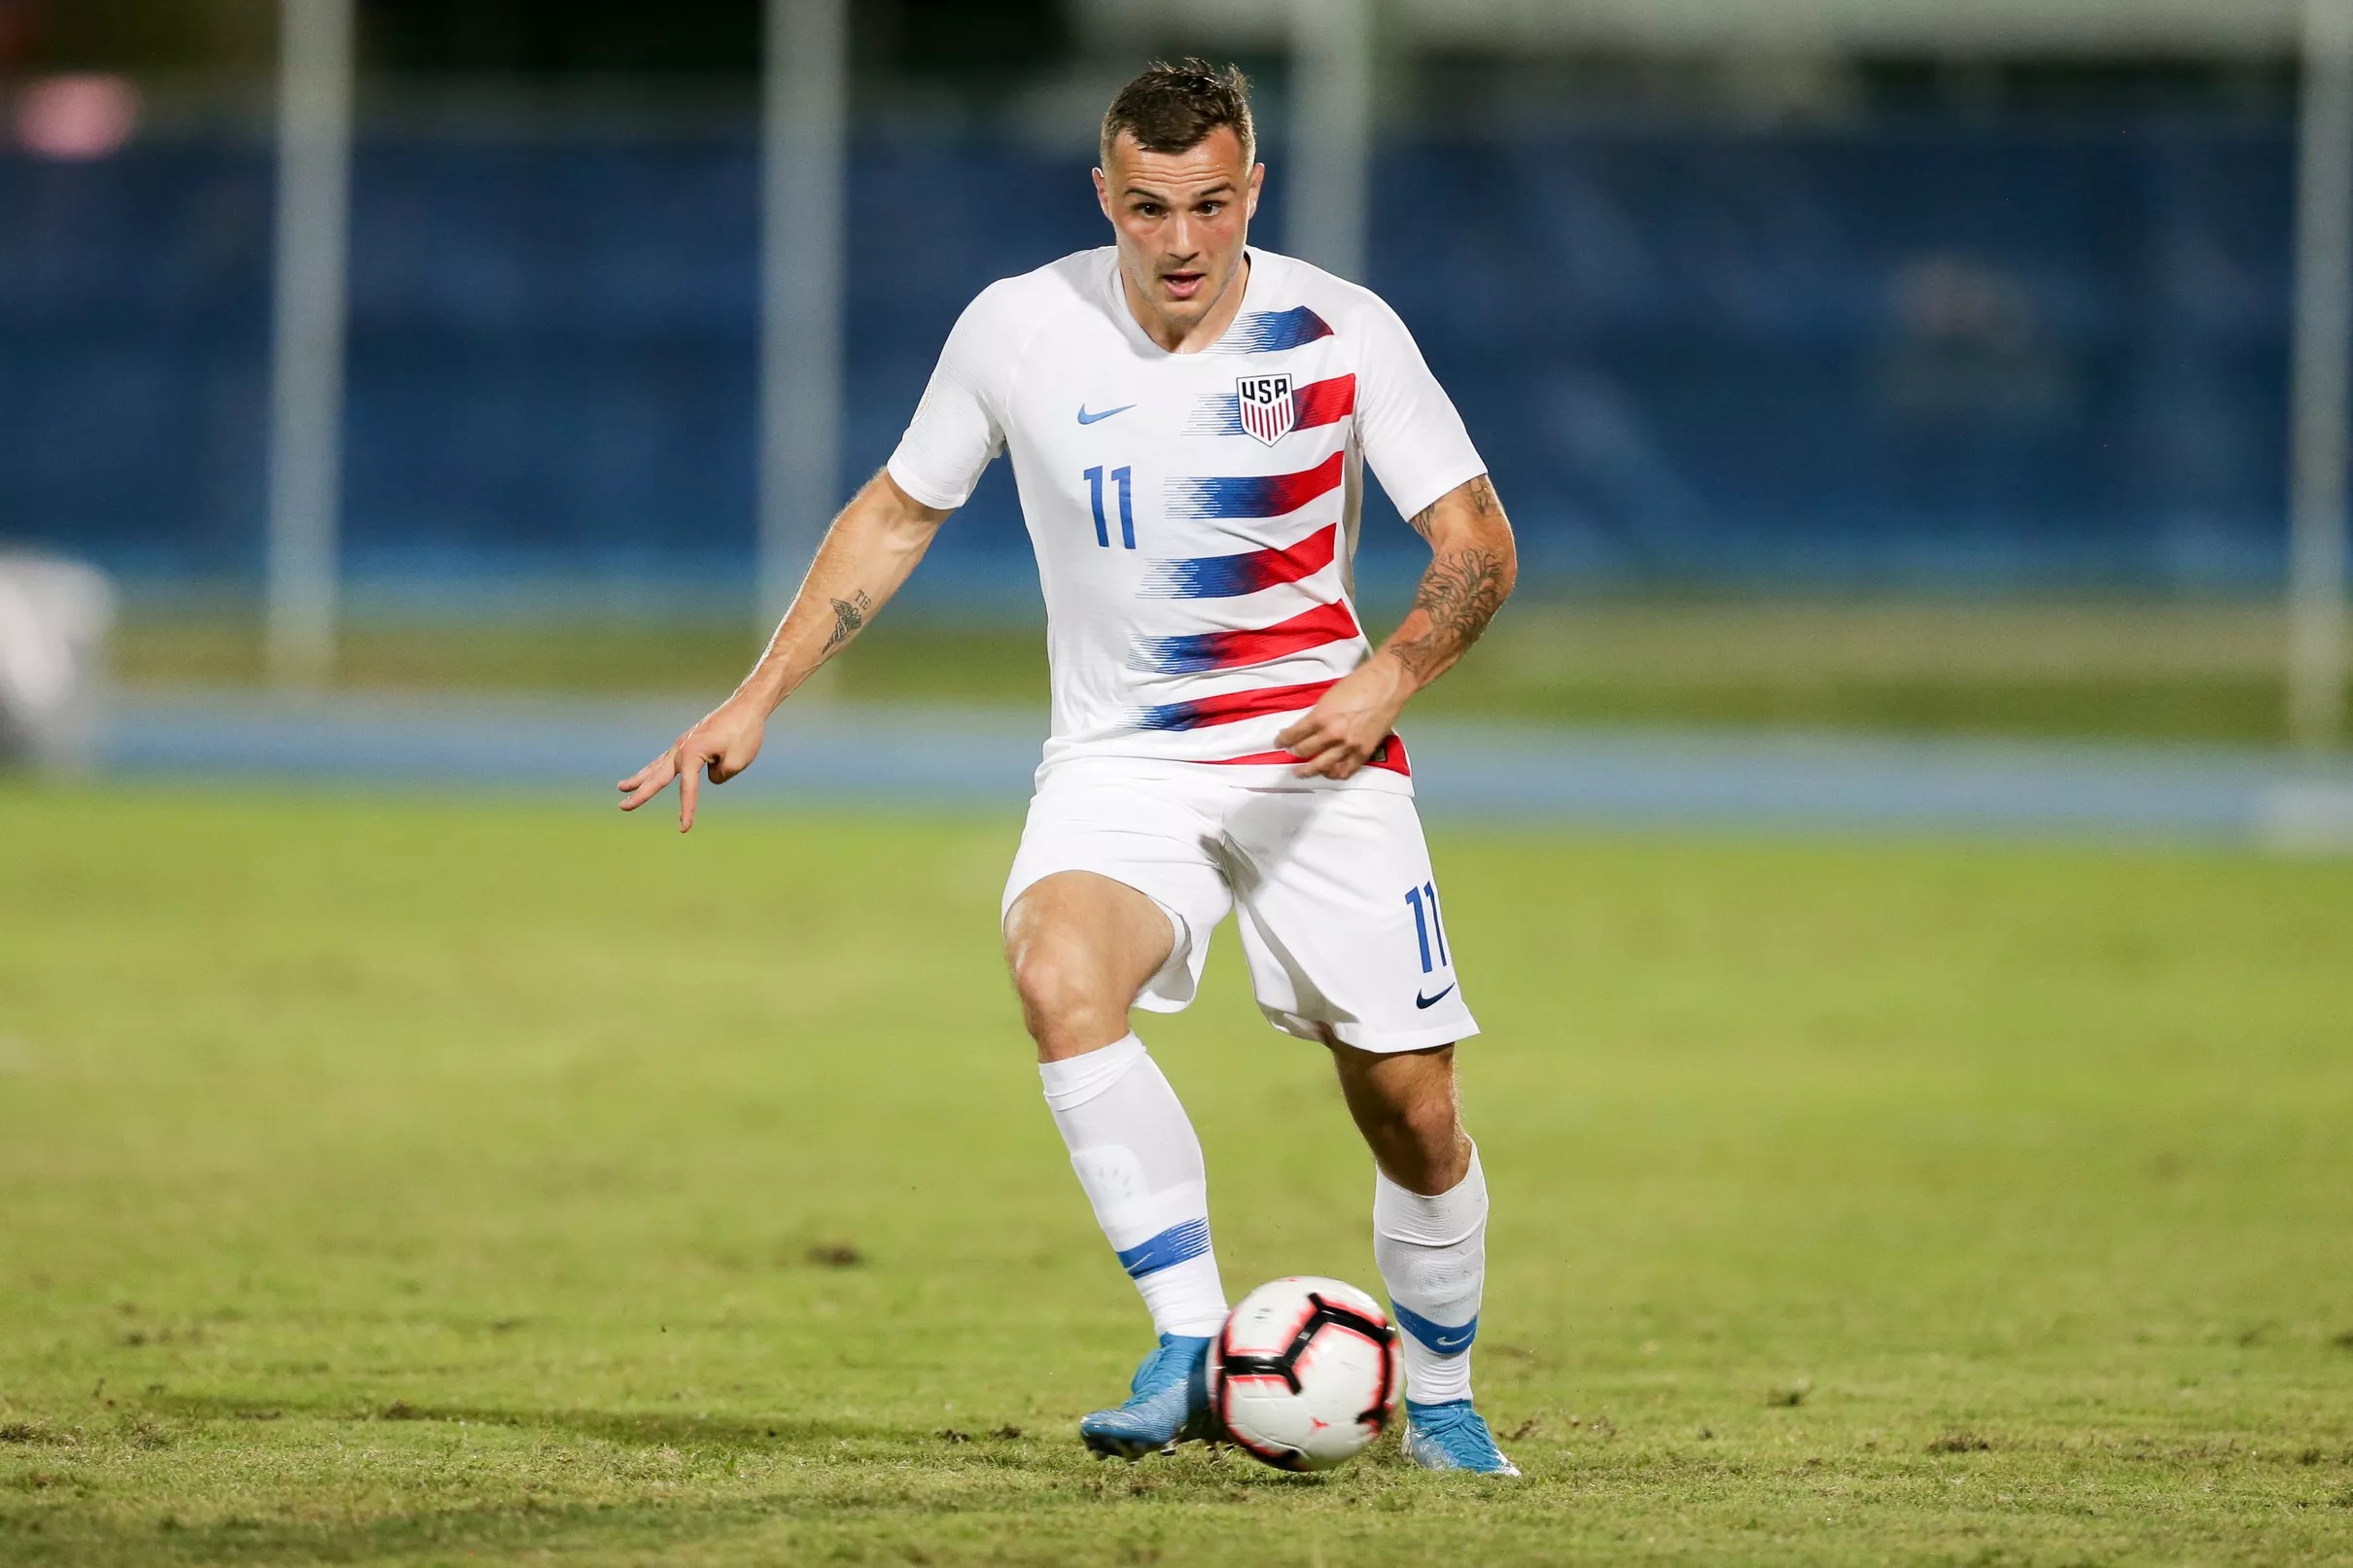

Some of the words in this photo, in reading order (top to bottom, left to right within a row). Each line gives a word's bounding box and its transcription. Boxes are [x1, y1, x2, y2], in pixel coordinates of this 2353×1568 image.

[1242, 378, 1287, 404] USA
[1083, 465, 1137, 550] 11
[1404, 880, 1448, 974] 11
